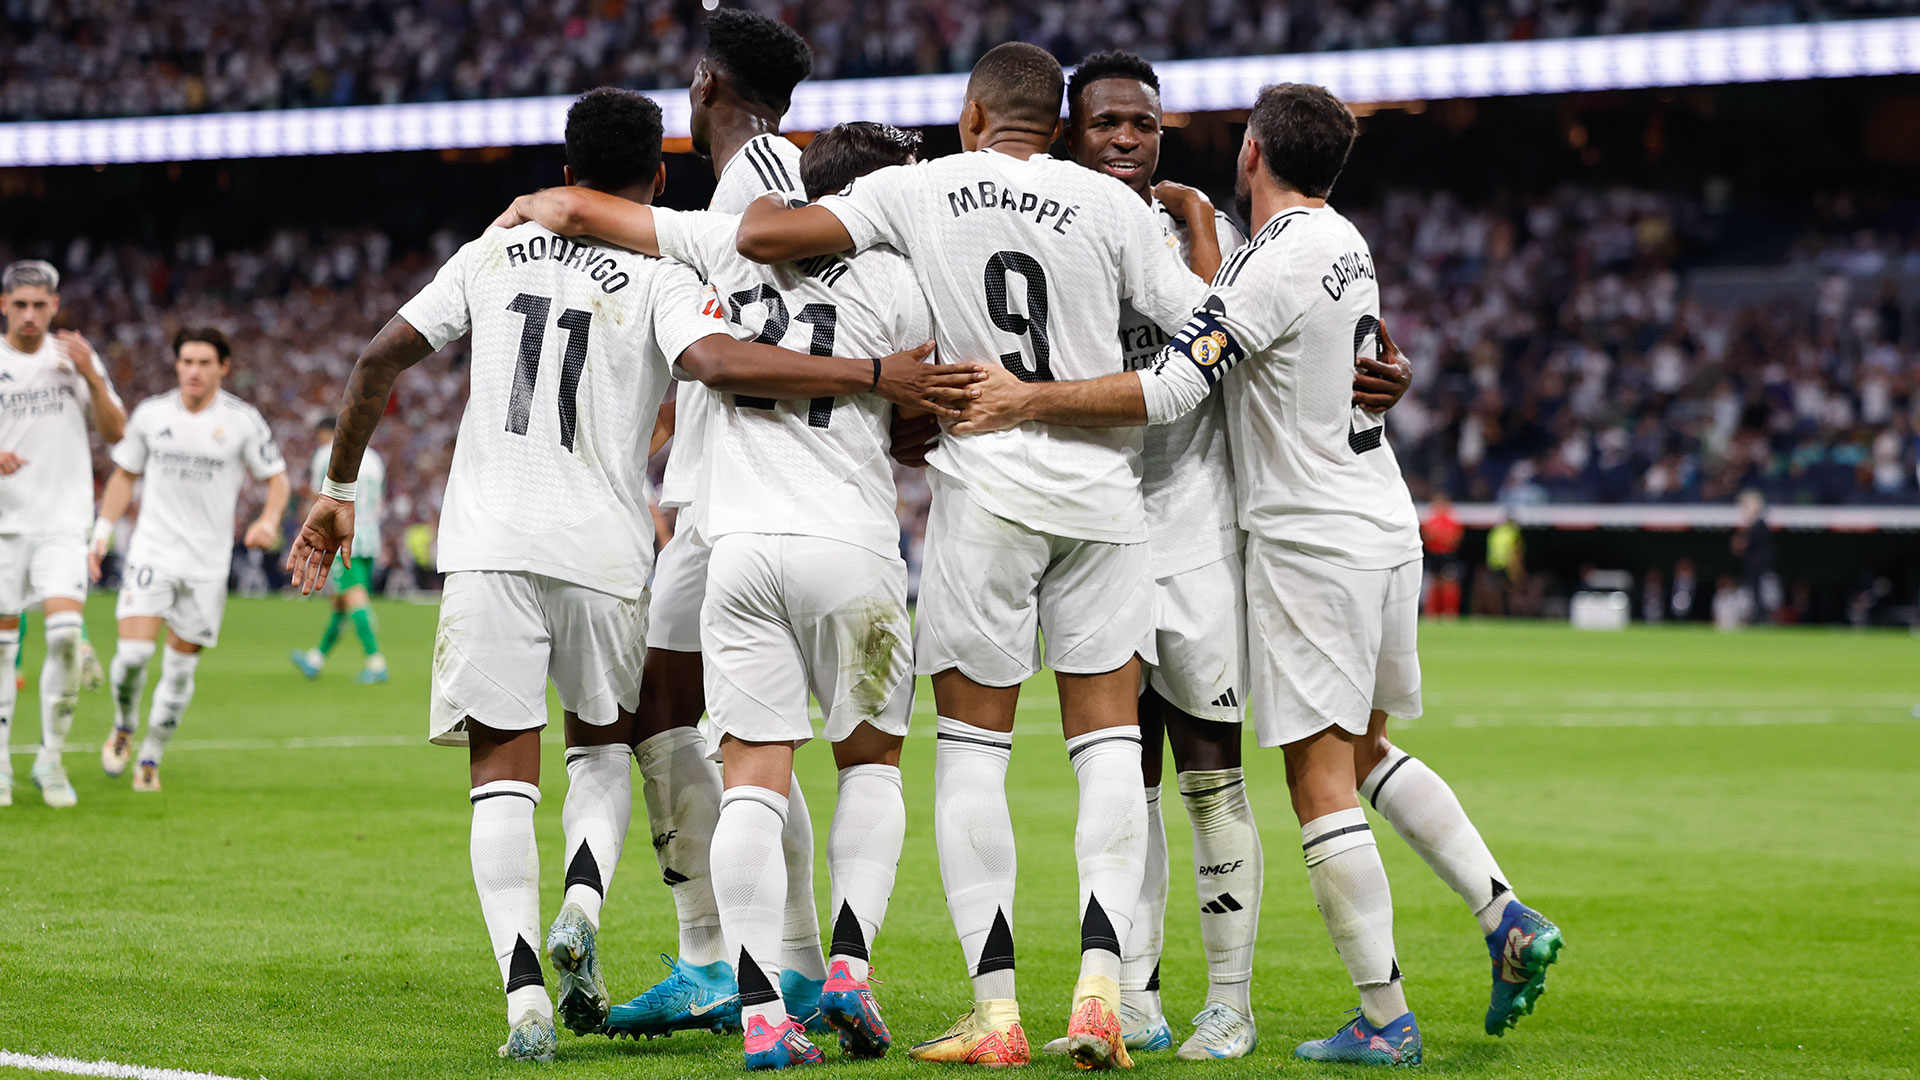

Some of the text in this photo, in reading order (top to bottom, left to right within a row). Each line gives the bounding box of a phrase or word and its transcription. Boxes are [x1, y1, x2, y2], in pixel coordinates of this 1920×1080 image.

[948, 181, 1081, 235] MBAPPÉ
[506, 235, 630, 294] RODRYGO
[1321, 251, 1374, 301] CARVAJ
[728, 282, 837, 430] 21
[984, 250, 1055, 382] 9
[504, 292, 593, 454] 11
[1348, 314, 1382, 455] 2
[1199, 859, 1244, 876] RMCF
